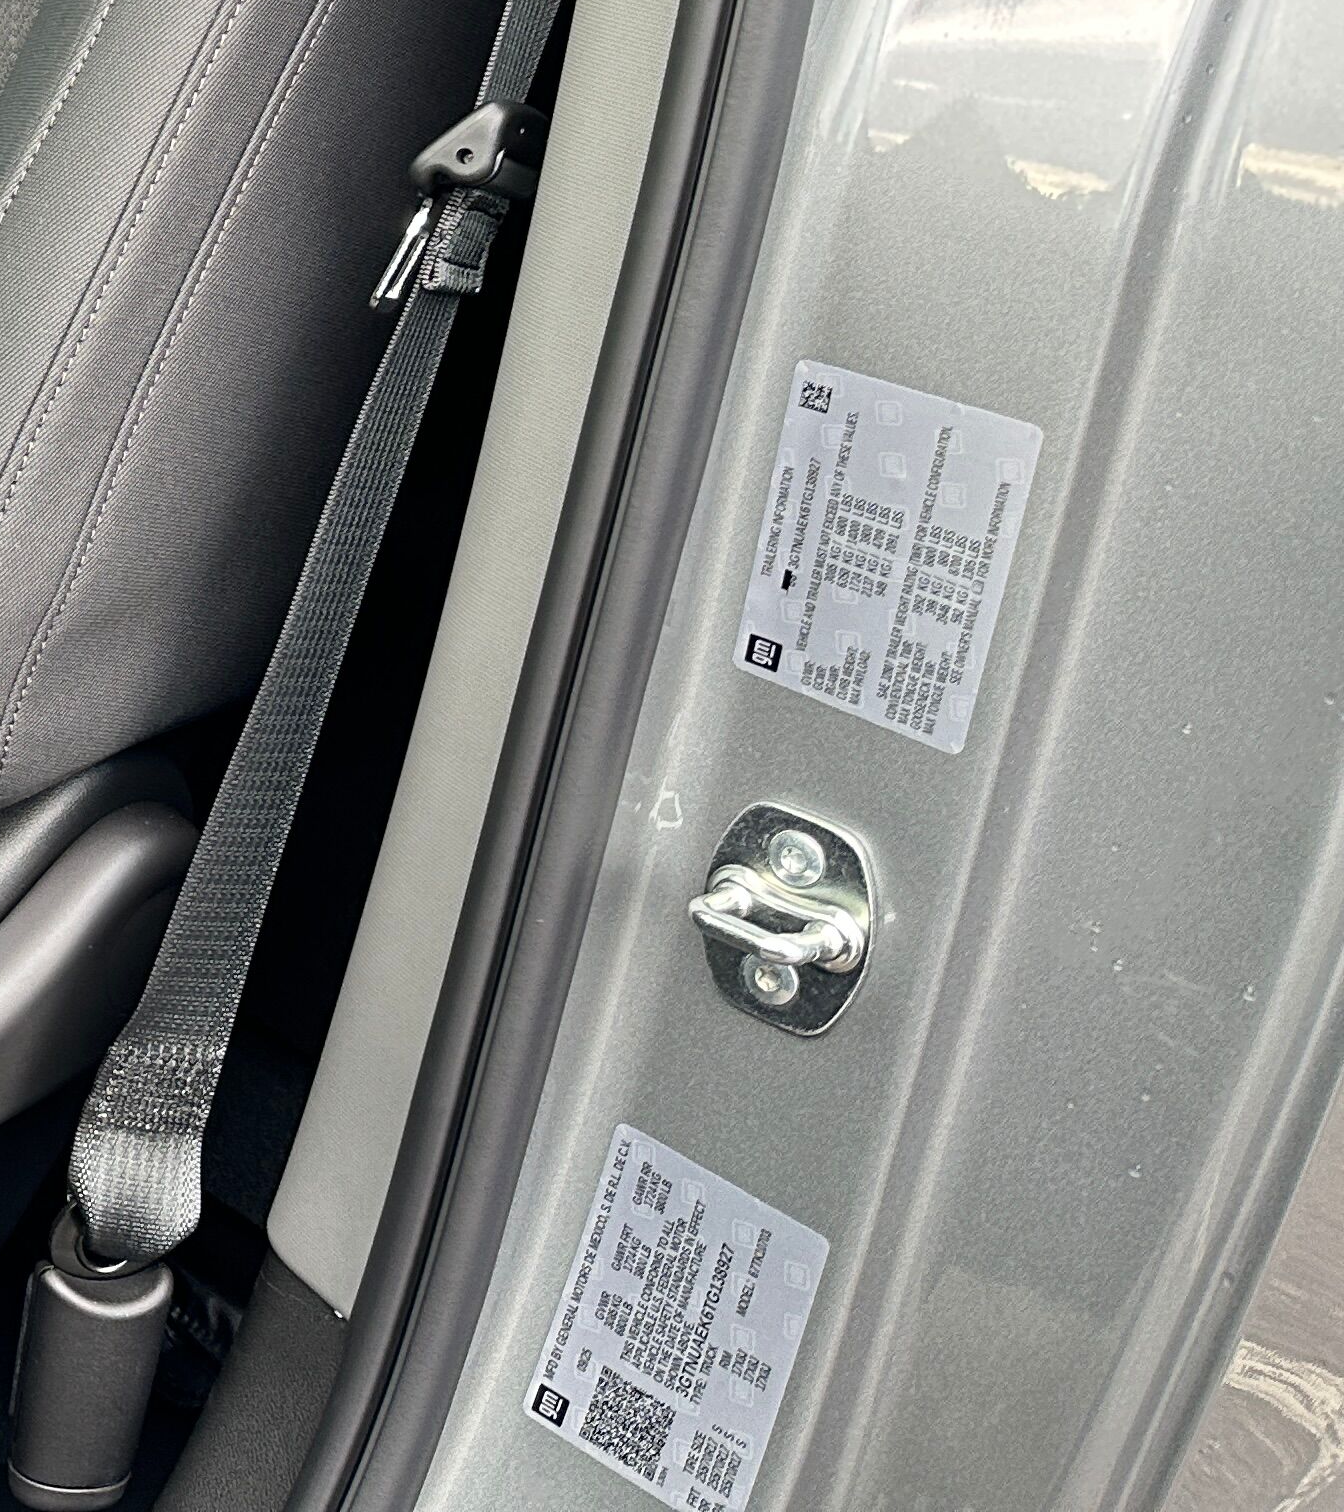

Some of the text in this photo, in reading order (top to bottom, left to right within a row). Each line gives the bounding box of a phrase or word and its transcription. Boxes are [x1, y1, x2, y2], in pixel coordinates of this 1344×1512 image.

[839, 491, 854, 513] LBS
[852, 496, 866, 517] LBS
[864, 500, 879, 521] LBS
[876, 504, 892, 526] LBS
[917, 488, 936, 524] VEHICLE
[984, 480, 1010, 537] INFORMATION
[760, 464, 795, 578] TRAILERING INFORMATION
[794, 409, 860, 653] VEHICLE AND TRAILER MUST NOT EXCEED ANY OF THESE VALUES.
[889, 508, 905, 530] LBS
[912, 522, 928, 543] FOR
[927, 523, 943, 545] LBS
[940, 528, 956, 550] LBS
[952, 532, 968, 554] LBS
[979, 534, 997, 561] MORE
[965, 537, 982, 559] LBS
[974, 559, 990, 579] FOR
[893, 593, 911, 627] WEIGHT
[961, 595, 982, 632] MANUAL
[750, 637, 776, 667] gm
[885, 624, 904, 660] TRAILER
[948, 667, 964, 686] SEE
[612, 1154, 626, 1172] DE
[602, 1186, 616, 1204] DE
[630, 1159, 653, 1207] GAWR RR
[659, 1177, 673, 1195] LB
[587, 1210, 610, 1252] MEXICO,
[582, 1248, 596, 1265] DE
[609, 1221, 634, 1273] GAWR FRT
[638, 1242, 652, 1260] LB
[569, 1261, 592, 1304] MOTORS
[619, 1215, 676, 1363] THIS VEHICLE CONFORMS TO ALL
[629, 1309, 659, 1370] APPLICABLE
[654, 1250, 678, 1296] FEDERAL
[667, 1215, 689, 1253] MOTOR
[640, 1198, 708, 1377] VEHICLE SAFETY STANDARDS IN EFFECT
[620, 1299, 634, 1317] LB
[652, 1238, 709, 1384] ON THE DATE OF MANUFACTURE
[554, 1299, 579, 1348] GENERAL
[549, 1344, 563, 1361] BY
[698, 1341, 719, 1377] TRUCK
[718, 1348, 733, 1370] RIM
[542, 1357, 559, 1382] MFD
[662, 1352, 684, 1392] SHOWN
[538, 1388, 563, 1421] gm
[681, 1428, 706, 1476] TIRE SIZE
